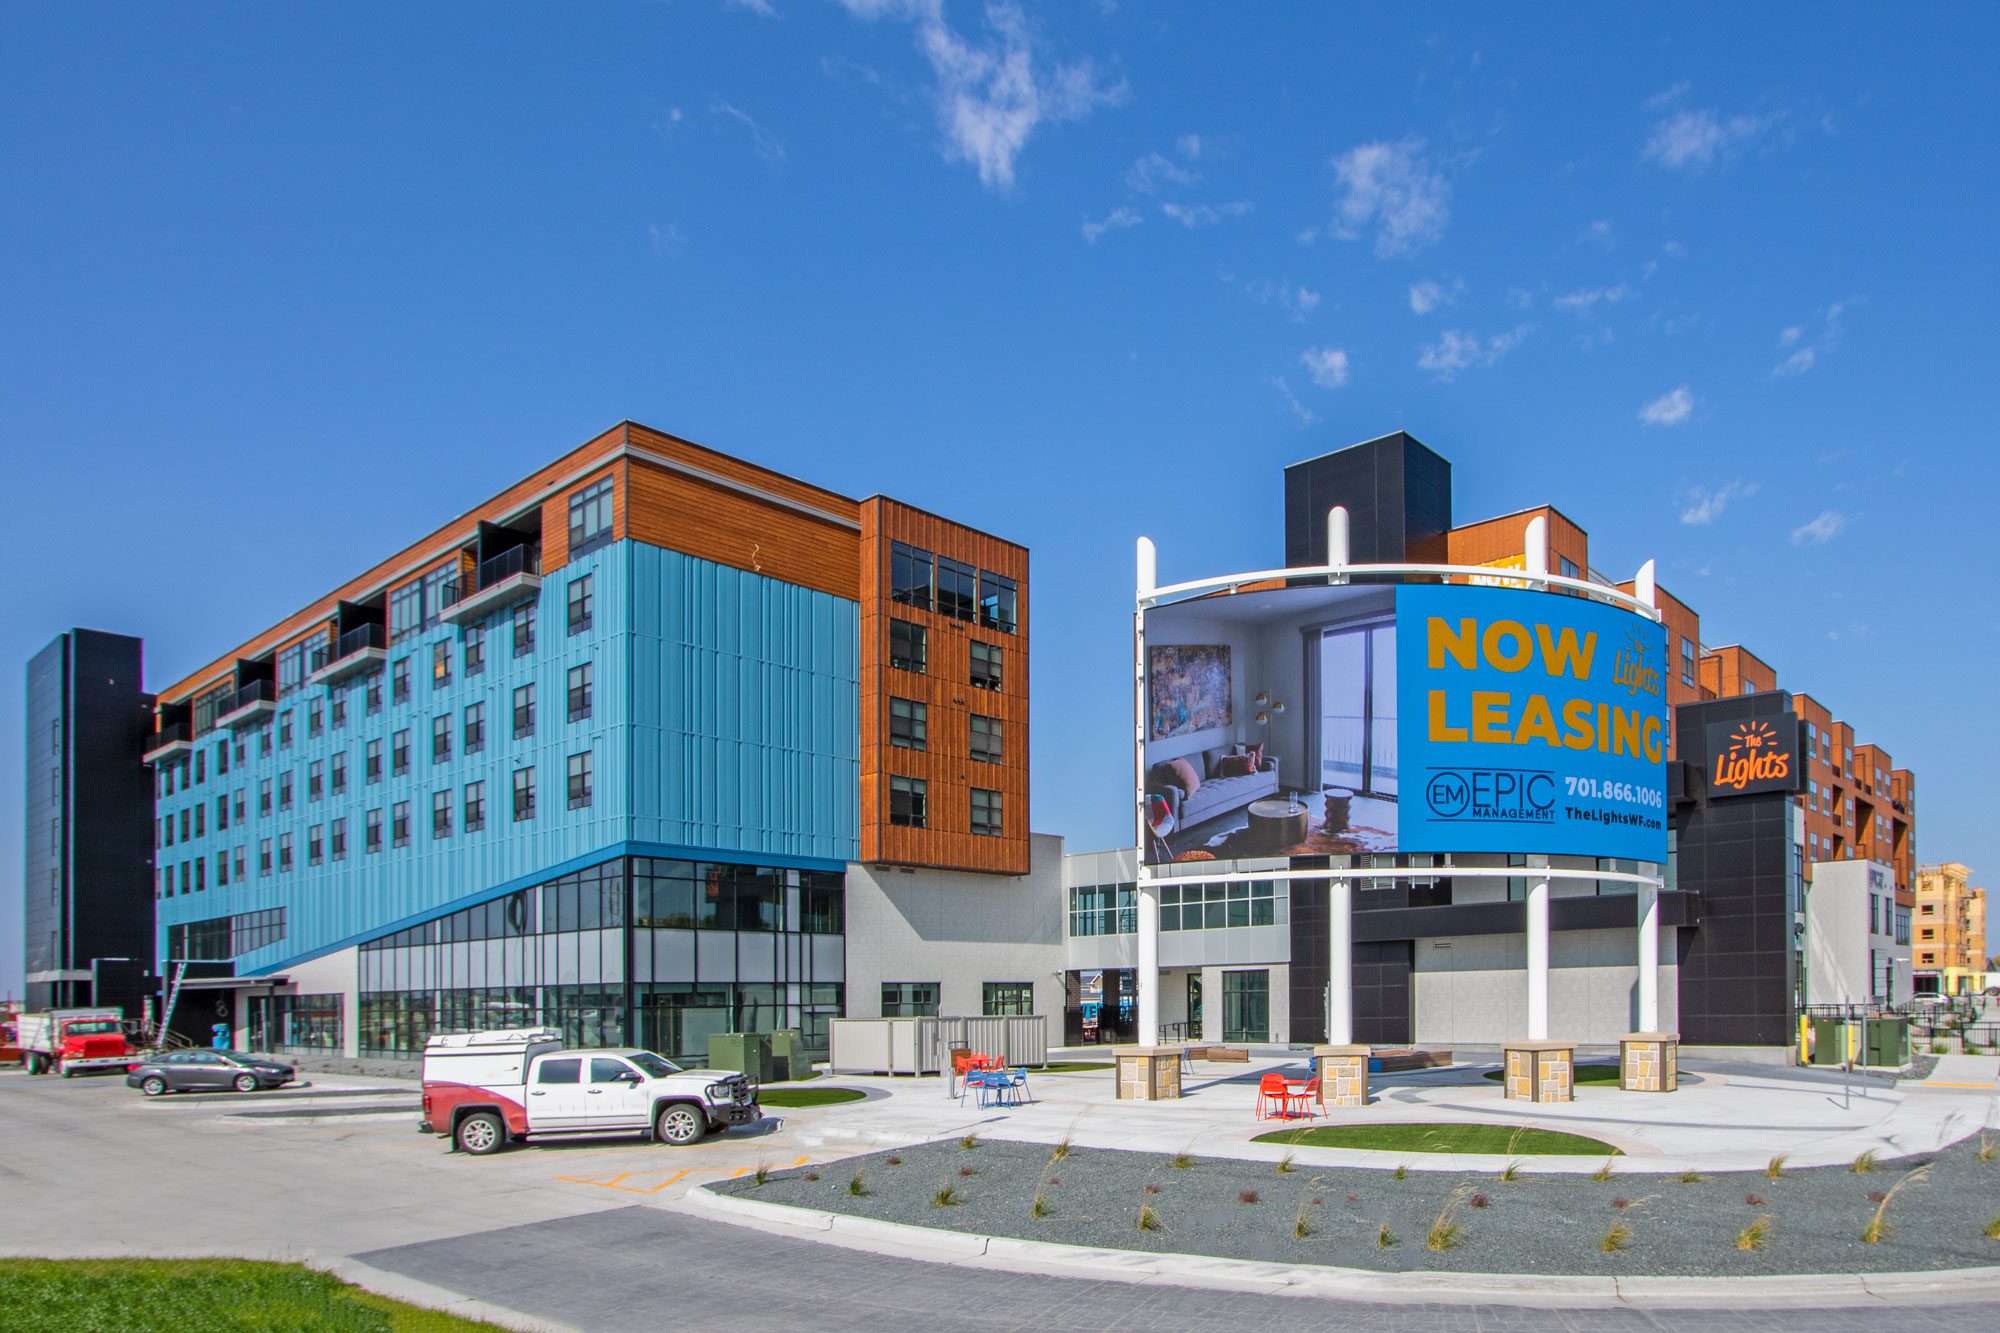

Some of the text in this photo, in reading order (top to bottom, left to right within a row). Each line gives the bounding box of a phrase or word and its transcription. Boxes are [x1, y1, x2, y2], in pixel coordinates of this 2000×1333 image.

[1427, 616, 1598, 681] NOW
[1613, 650, 1659, 697] Lights
[1428, 689, 1662, 765] LEASING
[1744, 734, 1762, 748] The
[1714, 748, 1790, 789] Lights
[1433, 785, 1464, 805] EM
[1472, 772, 1555, 810] EPIC
[1565, 776, 1662, 809] 701.866.1006
[1473, 808, 1555, 820] MANAGEMENT
[1565, 807, 1662, 831] TheLightsWF.com
